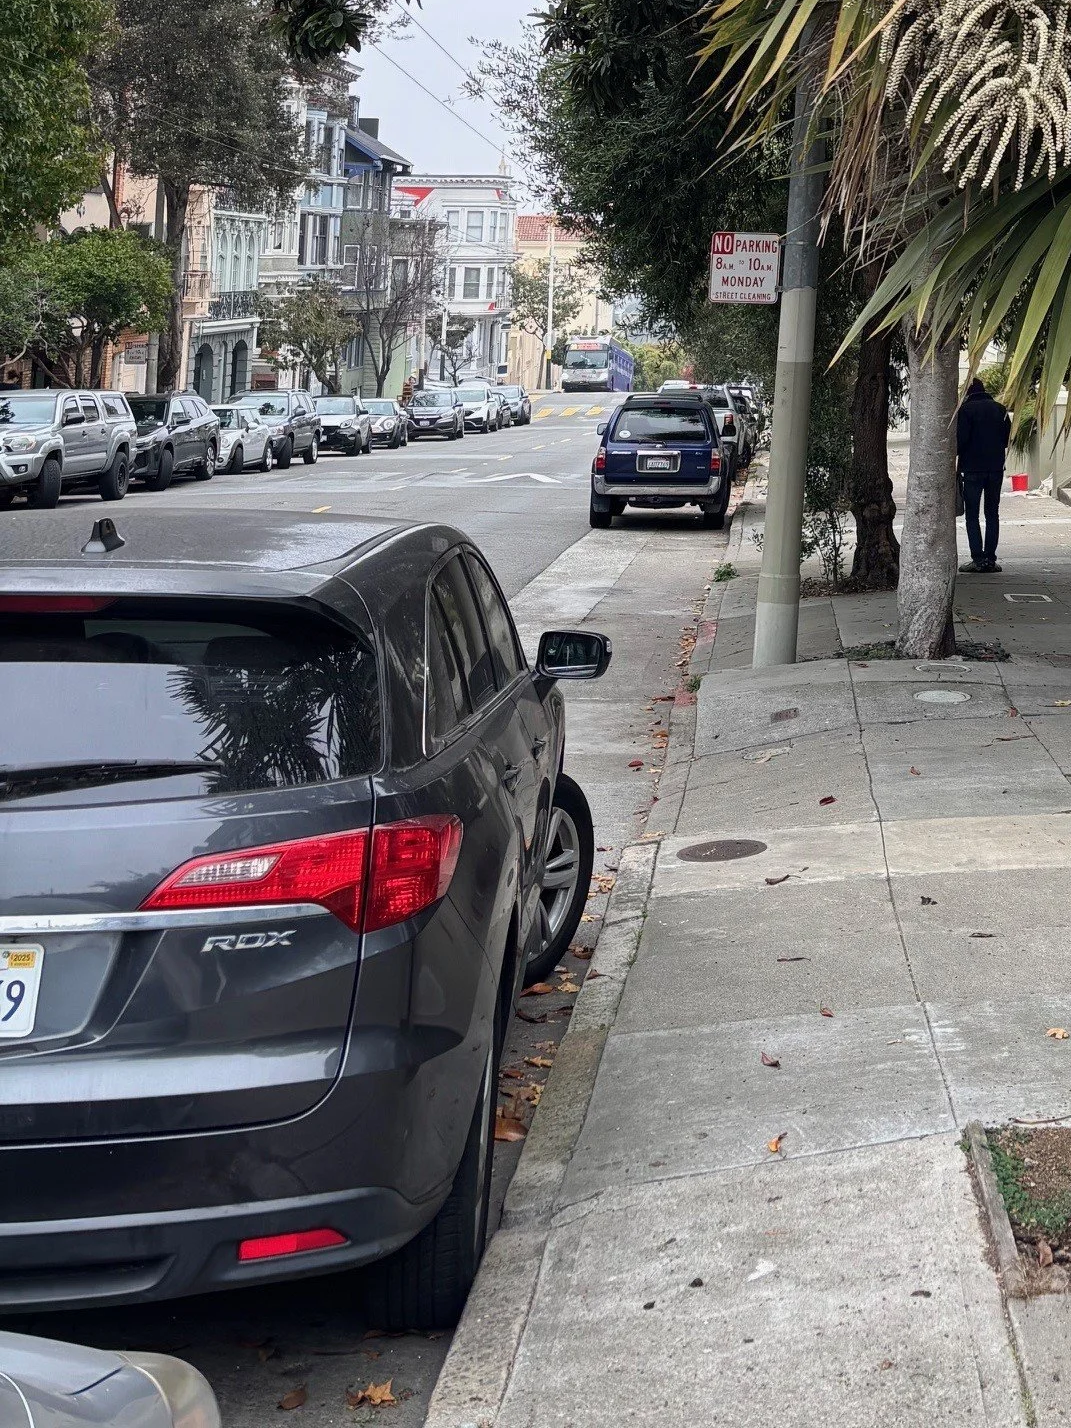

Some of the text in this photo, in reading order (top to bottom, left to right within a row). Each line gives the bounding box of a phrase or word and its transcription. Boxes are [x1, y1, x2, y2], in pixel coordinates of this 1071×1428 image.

[714, 235, 778, 253] NO PARKING
[721, 276, 766, 287] MONDAY
[715, 291, 771, 300] STREET CLEANING
[200, 930, 297, 953] RDX
[13, 954, 31, 962] 2025
